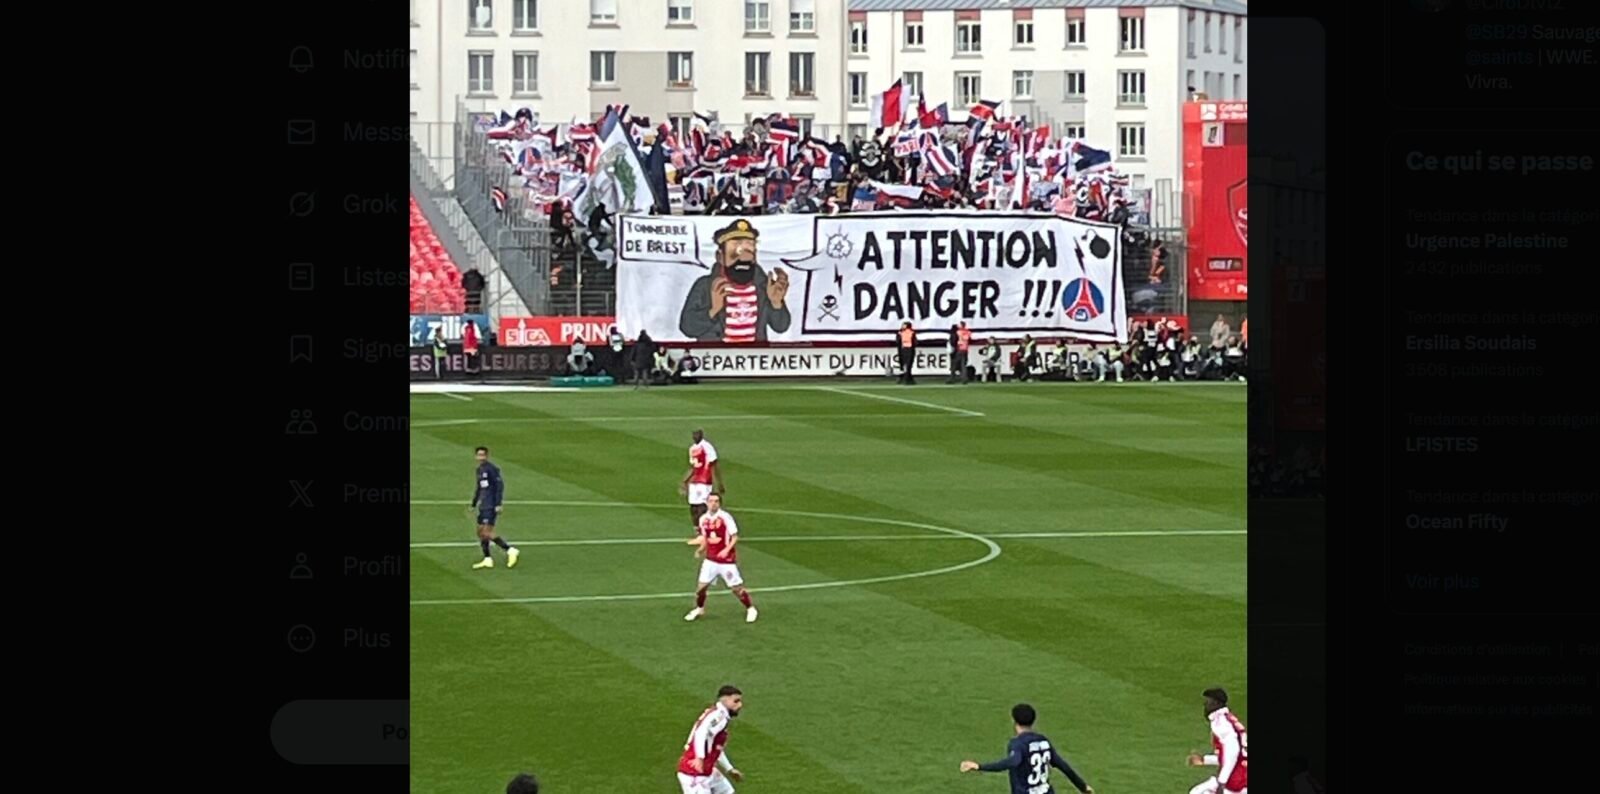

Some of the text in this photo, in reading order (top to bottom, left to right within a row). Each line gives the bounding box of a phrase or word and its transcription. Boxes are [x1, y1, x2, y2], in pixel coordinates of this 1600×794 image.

[625, 239, 686, 254] DE BREST
[857, 228, 1057, 270] ATTENTION
[853, 280, 1000, 321] DANGER
[829, 354, 854, 369] DU
[860, 350, 948, 370] FINISÈRE
[1027, 751, 1051, 785] 33
